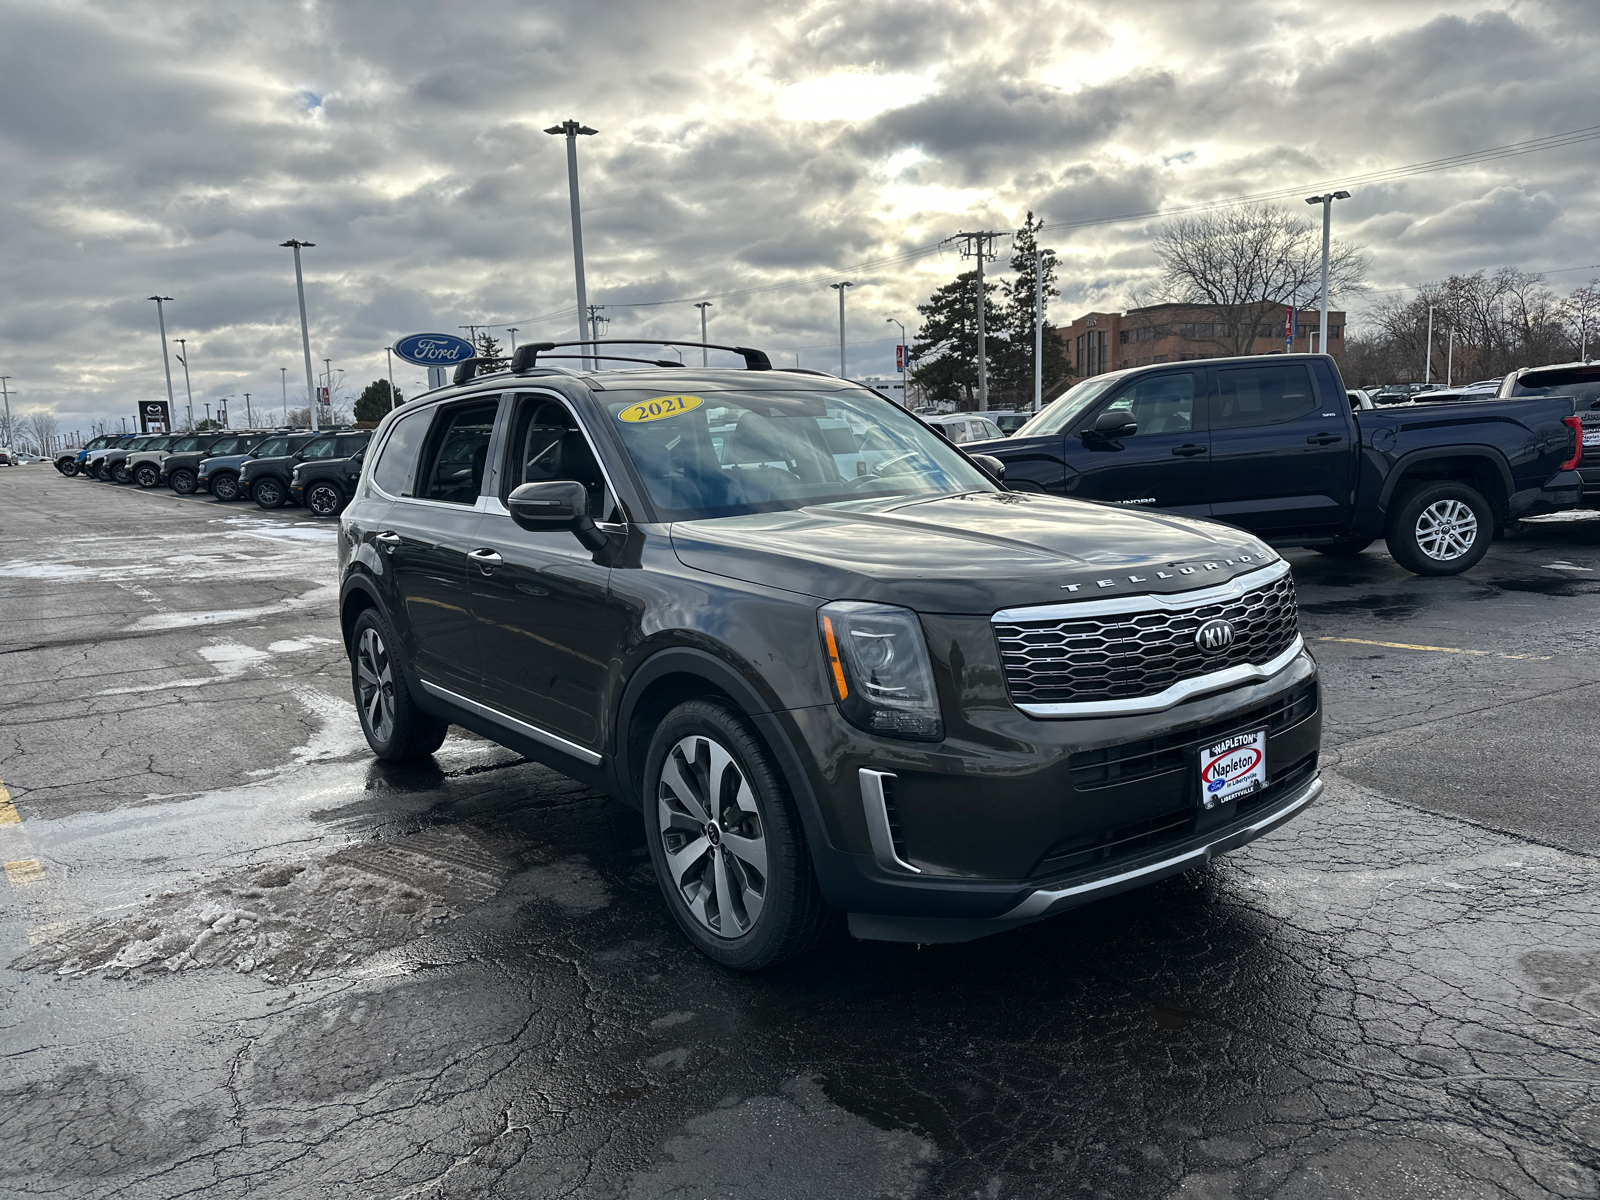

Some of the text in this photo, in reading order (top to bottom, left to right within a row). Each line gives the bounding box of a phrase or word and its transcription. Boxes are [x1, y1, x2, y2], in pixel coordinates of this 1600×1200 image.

[414, 339, 460, 359] Ford
[634, 397, 687, 420] 2021
[1060, 551, 1266, 592] TELLURIDE
[1204, 625, 1233, 648] KIA
[1212, 756, 1253, 779] Napleton
[1232, 773, 1257, 786] Libertyville
[1221, 787, 1254, 803] LIBERTYVILLE
